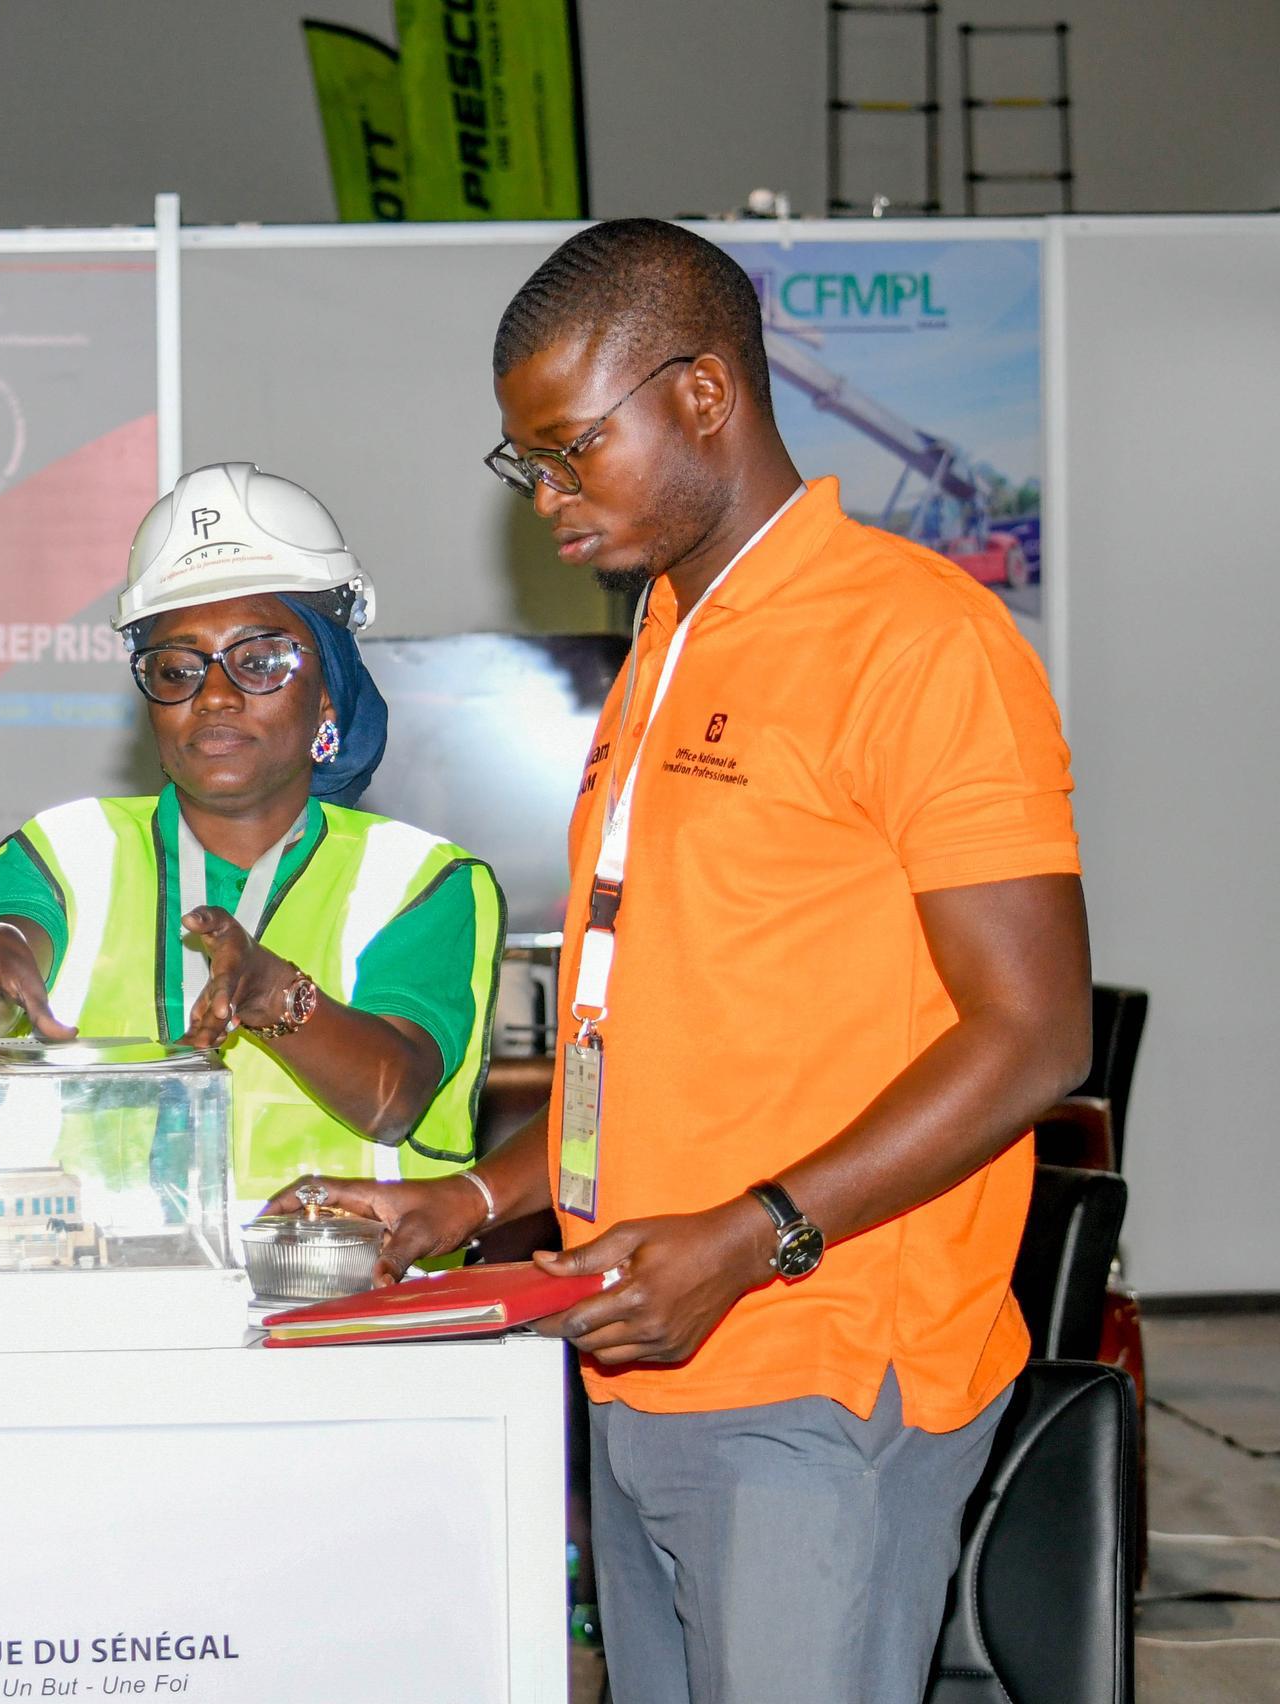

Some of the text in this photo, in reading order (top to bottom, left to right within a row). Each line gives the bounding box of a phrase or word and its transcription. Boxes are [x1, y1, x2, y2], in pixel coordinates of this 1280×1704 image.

[781, 272, 947, 319] CFMPL
[675, 748, 737, 770] Office National de
[691, 765, 749, 787] Professionnelle
[34, 1638, 80, 1665] DU
[92, 1630, 239, 1663] SÉNÉGAL
[3, 1679, 32, 1697] Un
[41, 1677, 78, 1696] But
[103, 1676, 146, 1695] Une
[155, 1674, 188, 1693] Foi
